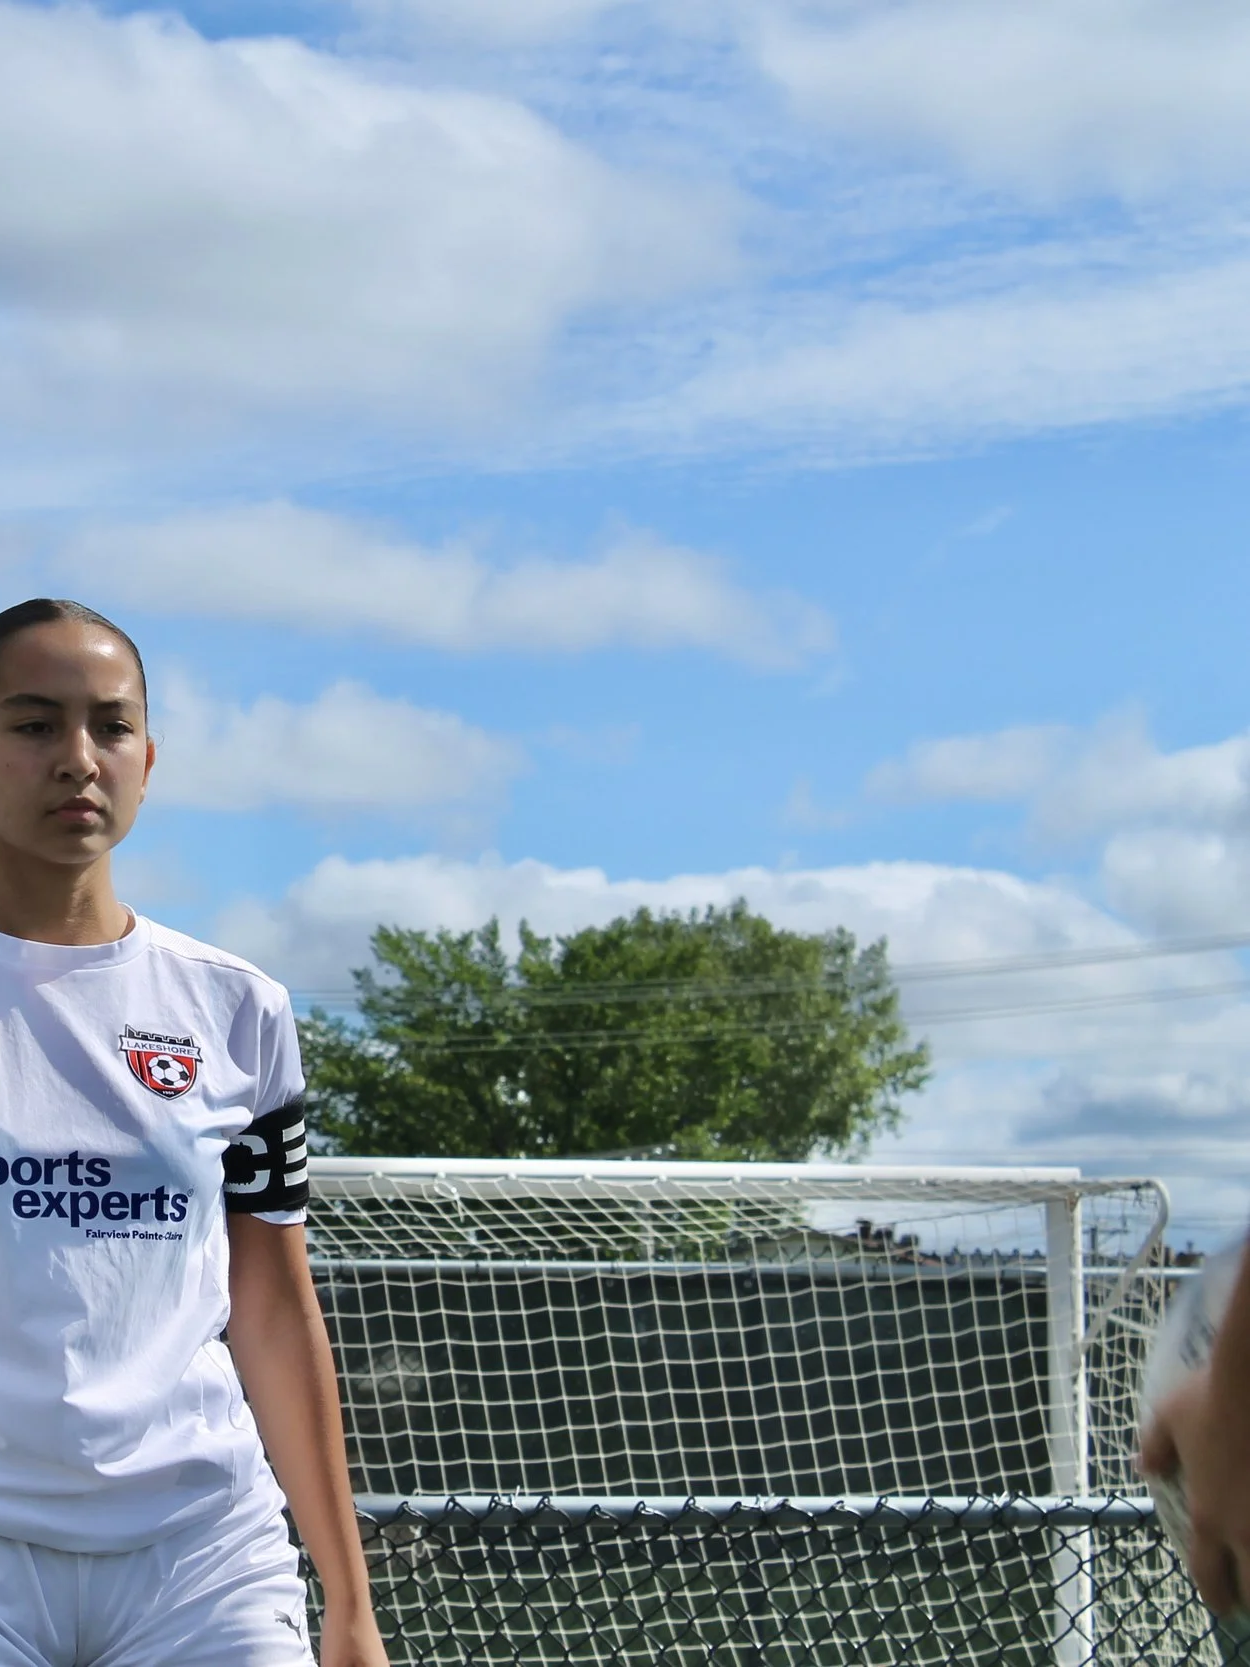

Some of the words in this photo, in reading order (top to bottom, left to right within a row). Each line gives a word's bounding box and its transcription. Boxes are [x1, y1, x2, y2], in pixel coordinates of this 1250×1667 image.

[126, 1041, 194, 1055] LAKESHORE
[85, 1229, 130, 1239] Fairview
[132, 1230, 183, 1240] Pointe-Claire
